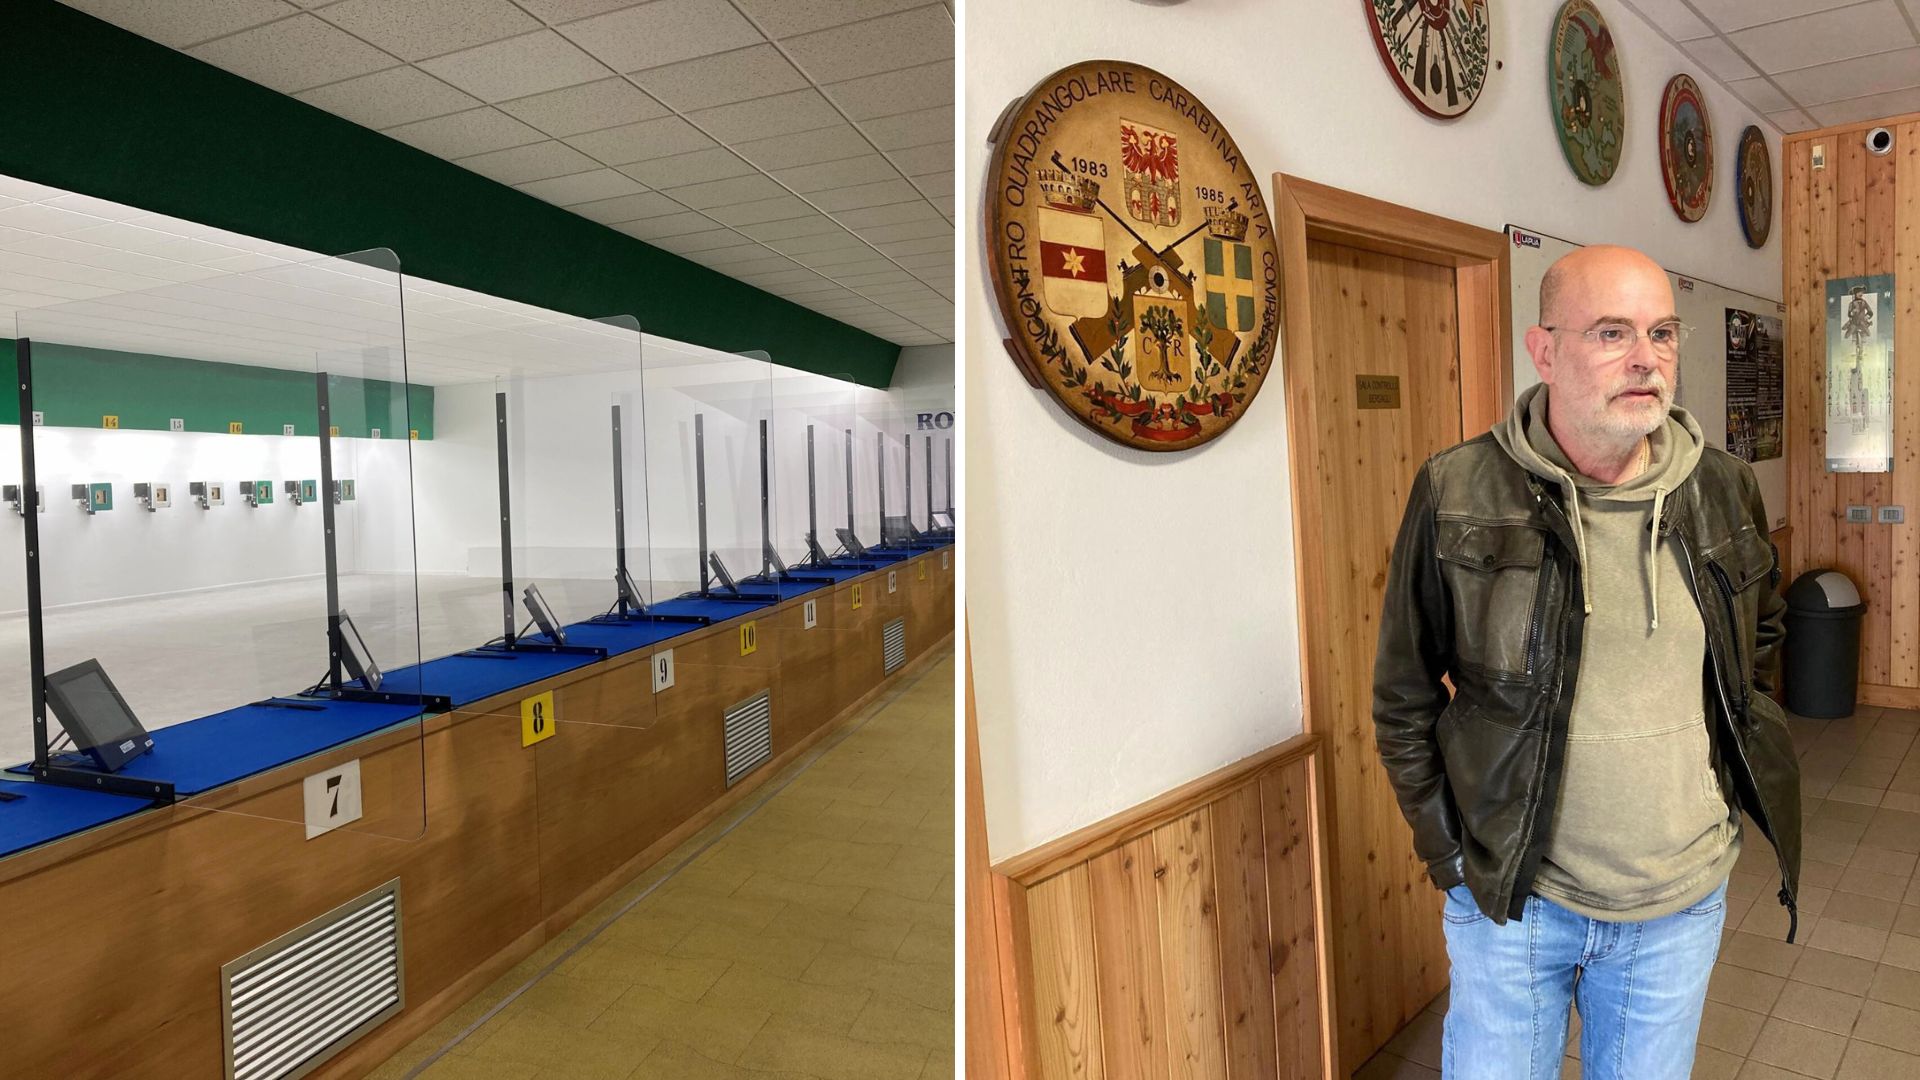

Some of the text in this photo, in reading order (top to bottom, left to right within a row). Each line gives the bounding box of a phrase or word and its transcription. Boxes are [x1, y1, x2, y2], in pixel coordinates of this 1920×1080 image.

[1005, 71, 1136, 208] QUADRANGOLARE
[1149, 79, 1238, 174] CARABINA
[1239, 182, 1269, 240] ARIA
[1071, 156, 1109, 178] 1983
[1195, 186, 1225, 204] 1985
[917, 411, 955, 430] RO
[807, 603, 814, 623] 11
[743, 627, 755, 650] 10
[659, 657, 668, 684] 9
[532, 701, 544, 735] 8
[326, 774, 343, 819] 7
